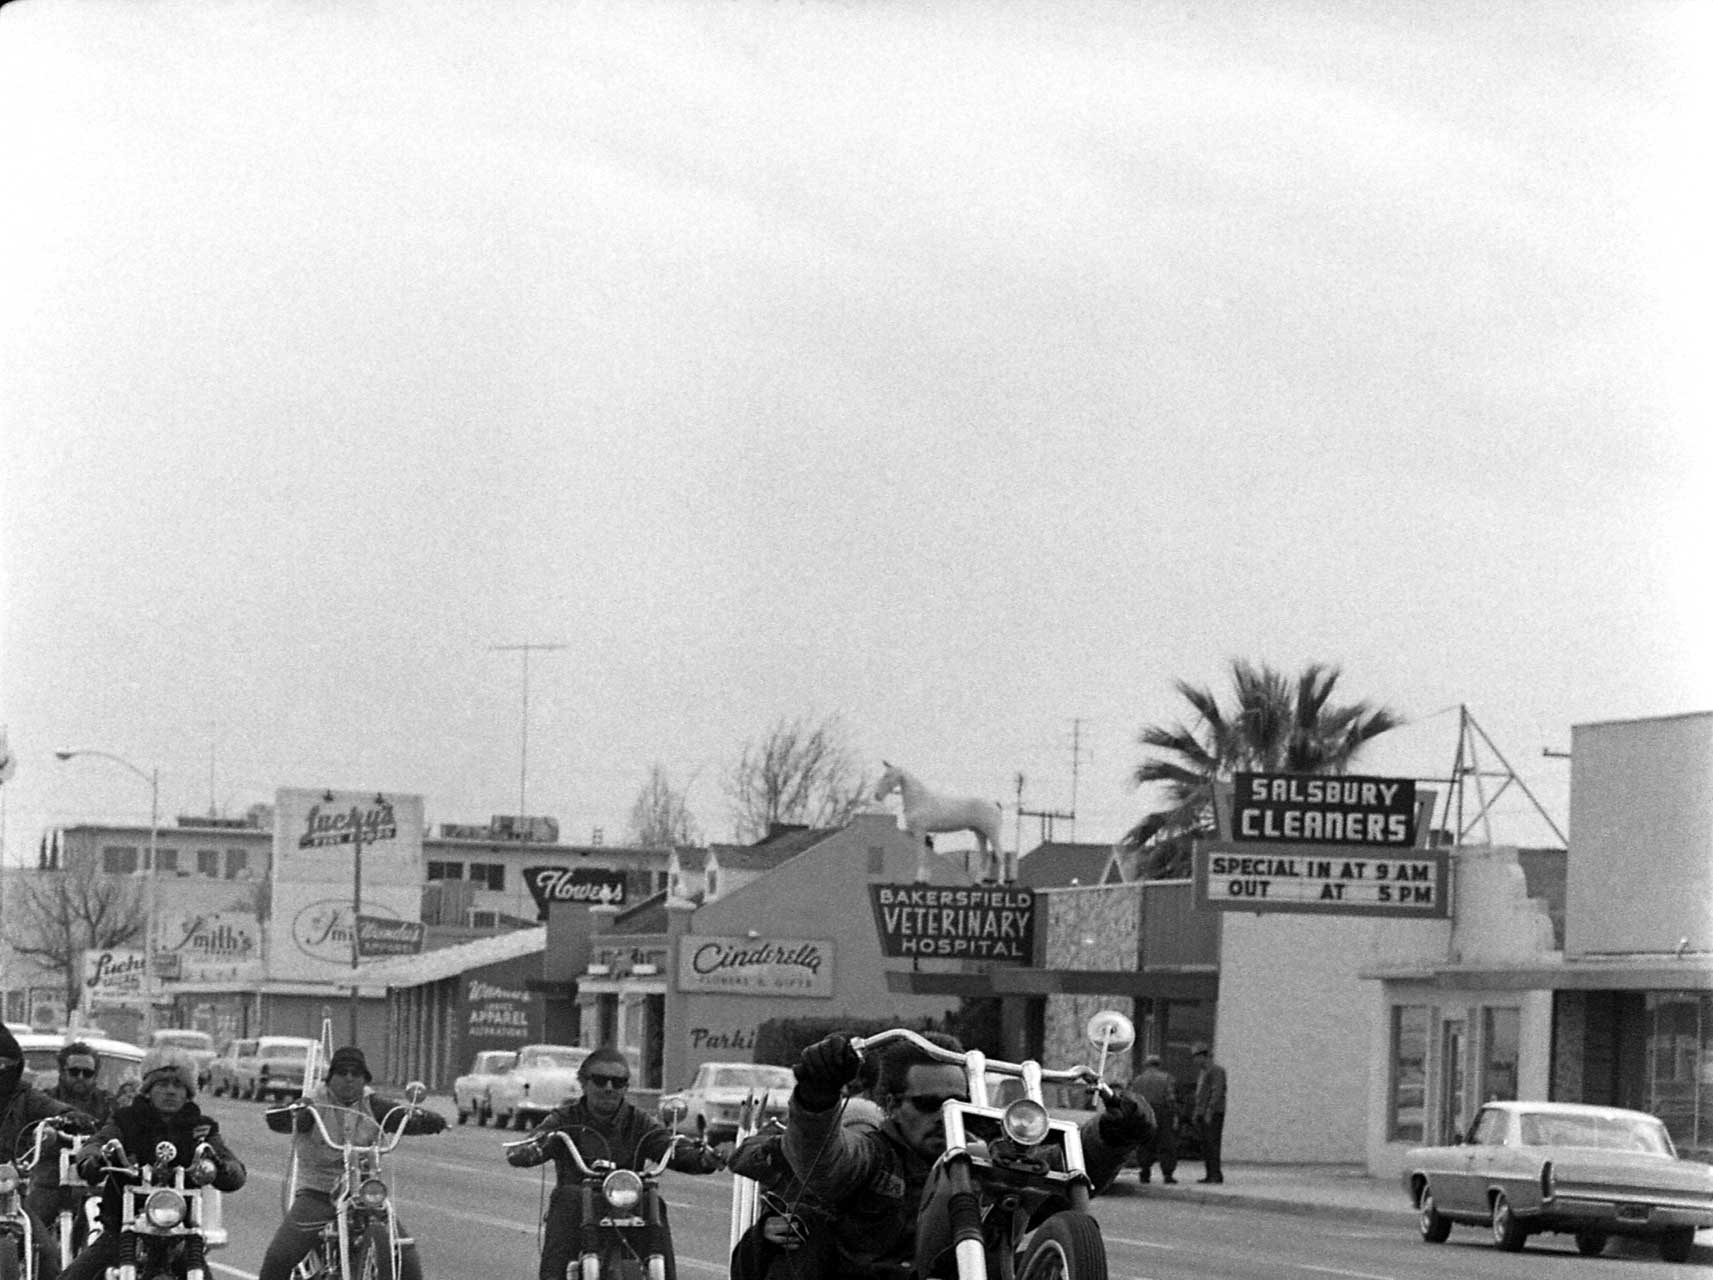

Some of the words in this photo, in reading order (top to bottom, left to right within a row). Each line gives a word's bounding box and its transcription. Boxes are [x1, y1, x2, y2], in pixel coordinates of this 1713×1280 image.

[1252, 779, 1399, 806] SALSBURY
[1242, 808, 1406, 841] CLEANERS
[1212, 857, 1299, 877] SPECIAL
[1307, 861, 1331, 878] IN
[1340, 862, 1366, 879] AT
[1376, 863, 1389, 880] 9
[1396, 864, 1429, 881] AM
[536, 870, 622, 900] Flowes
[1229, 880, 1271, 897] OUT
[1320, 884, 1345, 900] AT
[1378, 886, 1391, 901] 5
[1400, 886, 1431, 903] PM
[880, 889, 1031, 907] BAKERSFIELD
[884, 907, 1030, 937] VETERINARY
[693, 943, 821, 975] Cinderella
[902, 938, 1023, 956] HOSPITAL
[469, 1010, 528, 1025] APPAREL
[690, 1027, 755, 1048] Parki
